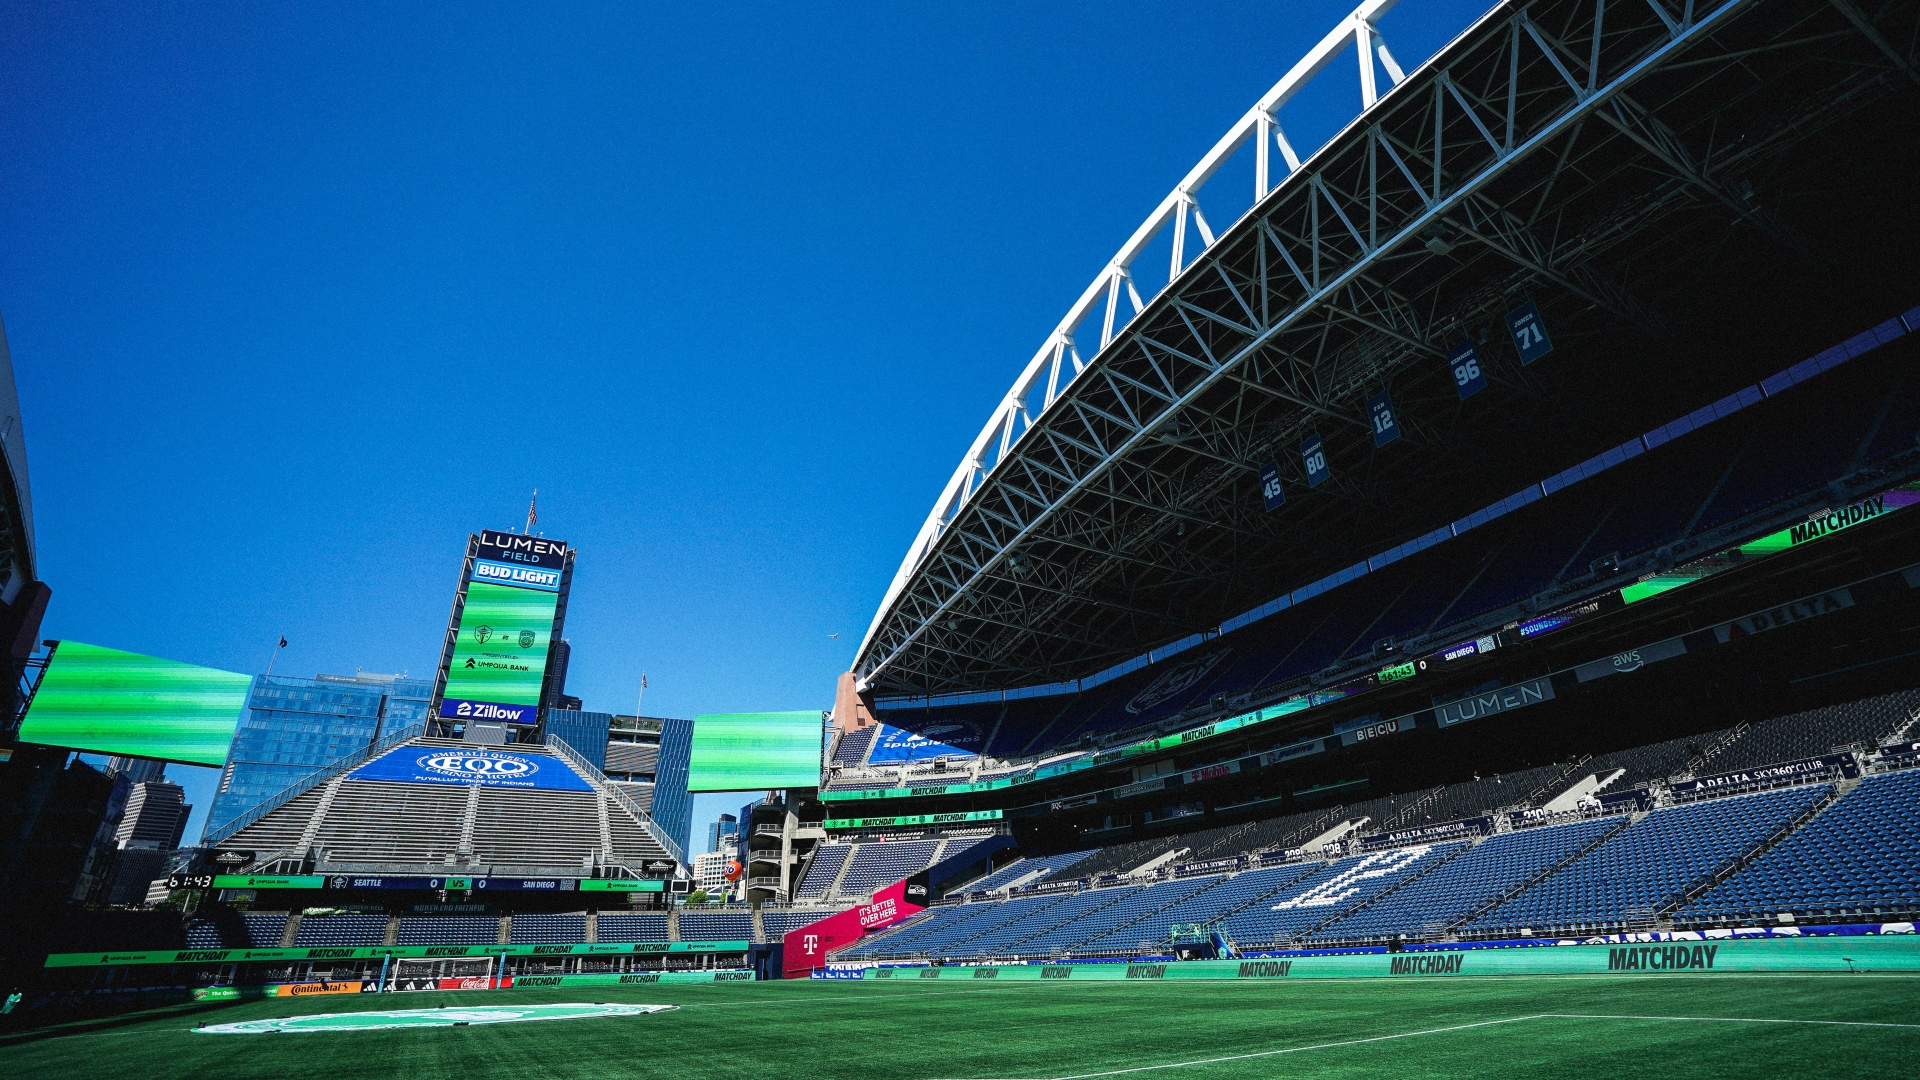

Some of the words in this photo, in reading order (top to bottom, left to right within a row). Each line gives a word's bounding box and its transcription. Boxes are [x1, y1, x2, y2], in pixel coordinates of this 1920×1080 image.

[1514, 312, 1533, 328] JONES
[1516, 322, 1543, 350] 71
[1454, 359, 1480, 386] 96
[1373, 410, 1394, 434] 12
[1306, 452, 1325, 475] 80
[1264, 477, 1281, 500] 45
[1790, 494, 1885, 544] MATCHDAY
[481, 533, 566, 556] LUMEN
[502, 550, 540, 563] FIELD
[478, 564, 511, 579] BUD
[512, 569, 557, 585] LIGHT
[1751, 595, 1841, 632] DELTA
[1445, 650, 1458, 661] SAN
[1458, 645, 1475, 657] DIEGO
[1612, 650, 1641, 667] aws
[478, 661, 508, 670] UMPQUA
[510, 664, 529, 672] BANK
[1420, 661, 1426, 670] 0
[1443, 683, 1542, 724] LUMEN
[473, 704, 521, 720] Zillow
[1181, 725, 1216, 743] MATCHDAY
[431, 752, 488, 763] EMERALD
[490, 753, 530, 764] QUEEN
[1093, 751, 1122, 765] MATCHDAY
[427, 757, 529, 775] EQC
[425, 766, 472, 778] CASINO
[486, 772, 530, 780] HOTEL
[1011, 773, 1038, 785] MATCHDAY
[911, 786, 947, 795] MATCHDAY
[1052, 802, 1062, 810] EQC
[861, 818, 896, 826] MATCHDAY
[933, 813, 968, 822] MATCHDAY
[1396, 830, 1421, 840] DELTA
[1190, 862, 1209, 870] DELTA
[353, 879, 382, 887] SEATTLE
[430, 879, 438, 888] 0
[452, 880, 465, 888] VS
[478, 879, 486, 888] 0
[859, 906, 871, 916] IT'S
[872, 898, 896, 912] BETTER
[860, 912, 879, 925] OVER
[879, 907, 897, 919] HERE
[307, 949, 356, 958] MATCHDAY
[425, 947, 469, 955] MATCHDAY
[533, 945, 573, 954] MATCHDAY
[633, 944, 671, 952] MATCHDAY
[174, 950, 231, 961] MATCHDAY
[1608, 945, 1718, 970] MATCHDAY
[1238, 961, 1292, 977] MATCHDAY
[1390, 954, 1464, 974] MATCHDAY
[714, 972, 752, 981] MATCHDAY
[973, 968, 999, 978] MATCHDAY
[1040, 967, 1073, 979] MATCHDAY
[1126, 965, 1167, 978] MATCHDAY
[518, 977, 563, 986] MATCHDAY
[619, 975, 660, 983] MATCHDAY
